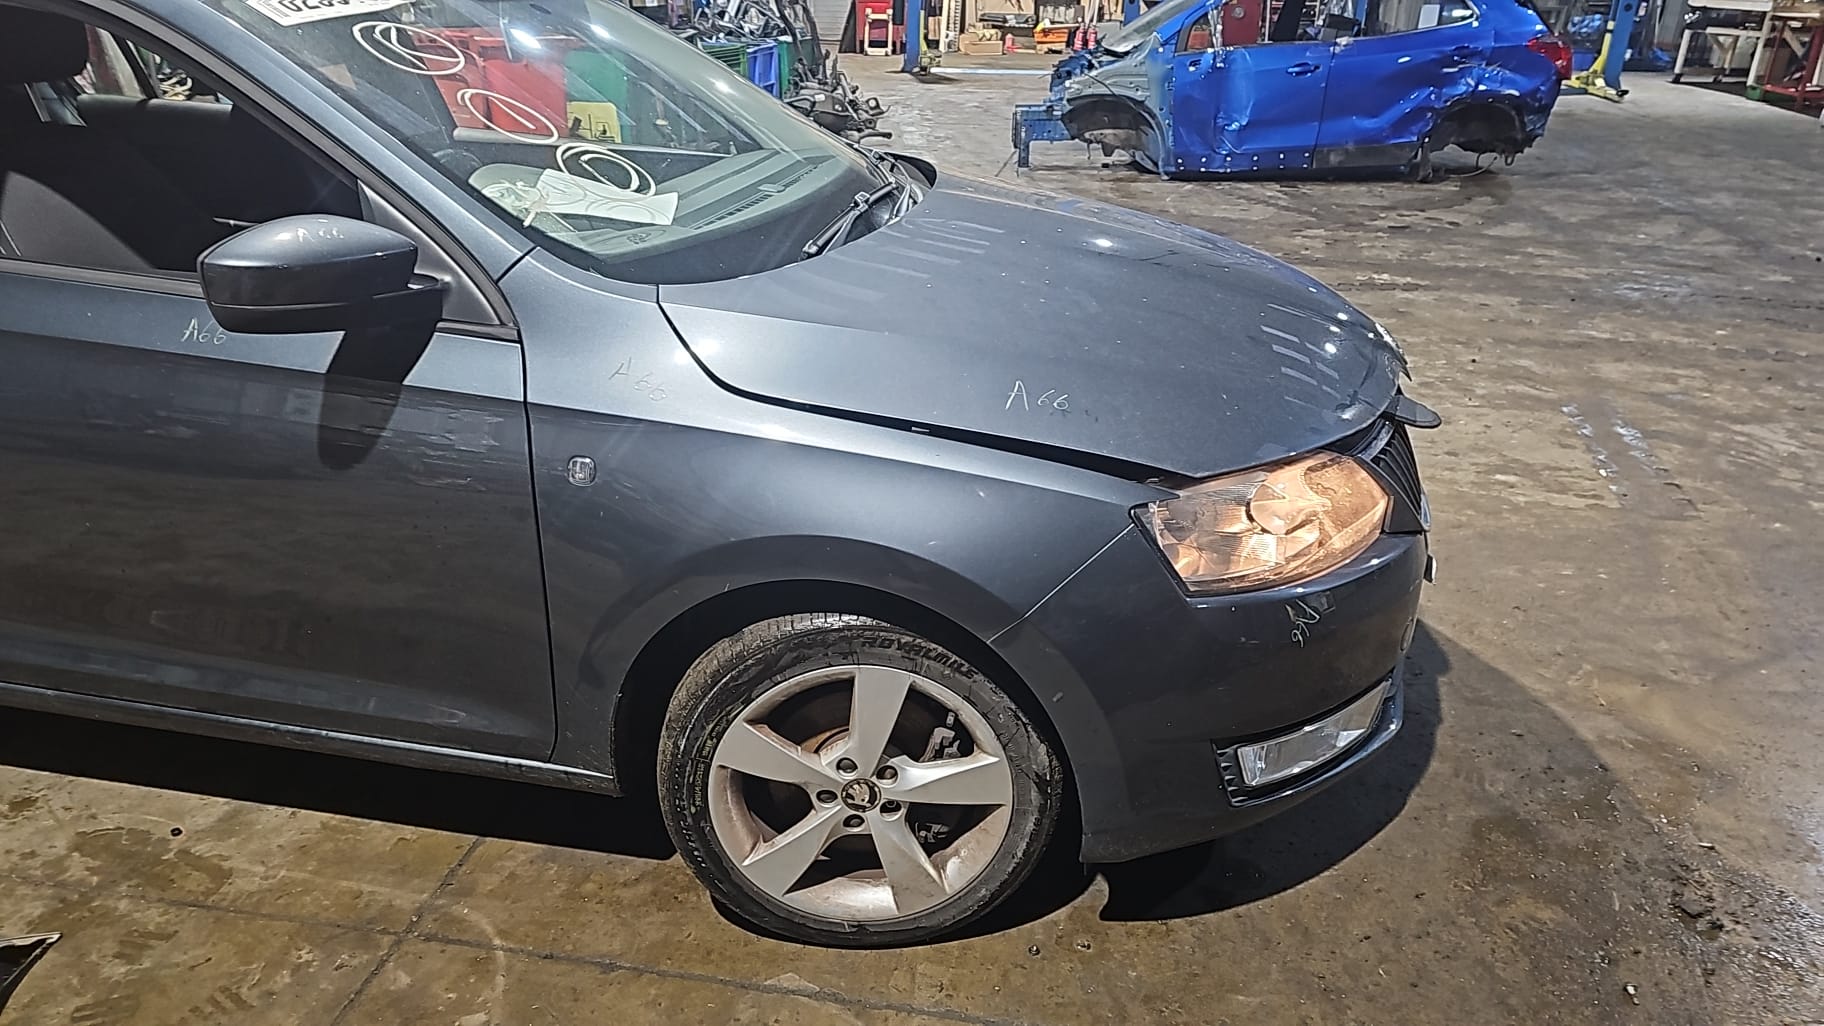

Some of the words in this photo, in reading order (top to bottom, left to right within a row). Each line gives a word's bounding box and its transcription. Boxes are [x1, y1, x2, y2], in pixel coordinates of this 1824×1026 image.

[181, 317, 227, 345] A66
[607, 356, 667, 402] A66
[1004, 380, 1069, 411] A66
